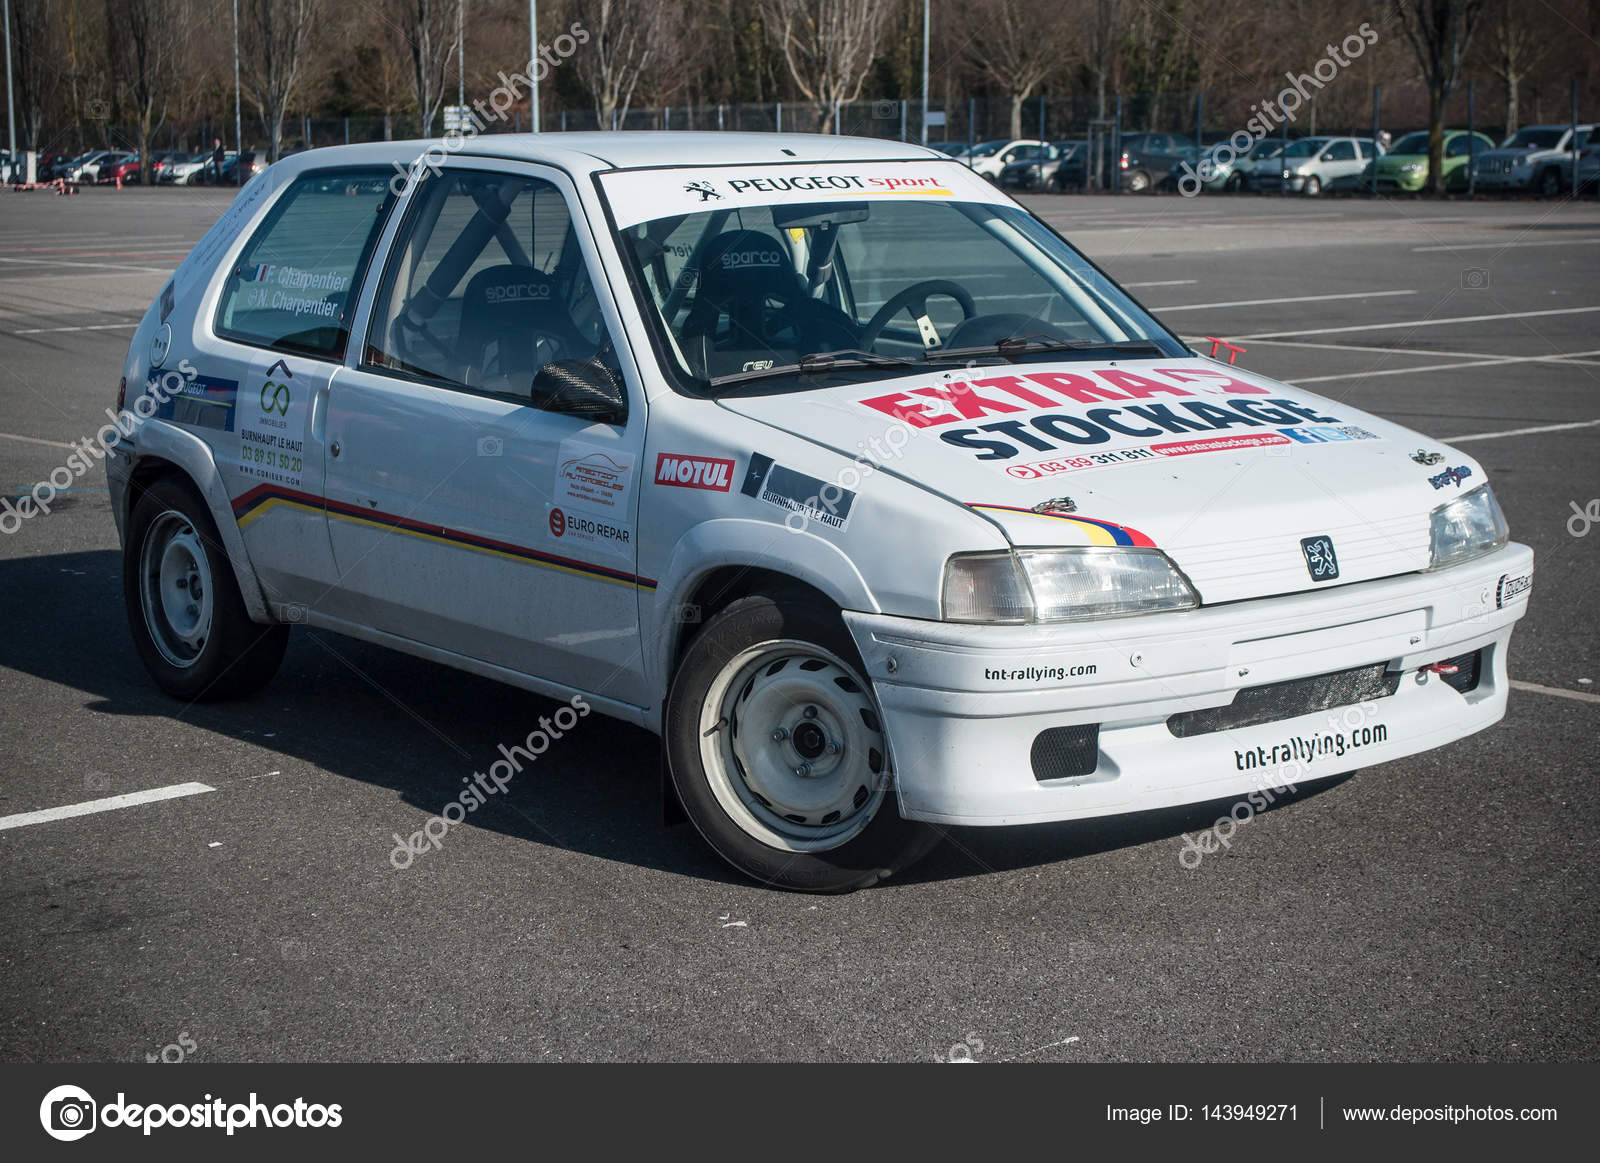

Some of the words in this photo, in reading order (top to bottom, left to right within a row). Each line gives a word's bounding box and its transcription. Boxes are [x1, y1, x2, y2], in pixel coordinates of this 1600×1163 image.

[728, 175, 865, 194] PEUGEOT
[868, 175, 946, 192] sport
[721, 250, 780, 268] sparco
[265, 264, 275, 284] F.
[278, 266, 348, 293] Charpentier
[272, 290, 338, 317] Charpentier
[485, 283, 550, 303] sparco
[858, 368, 1172, 430] EXTRA
[940, 397, 1342, 460] STOCKAGE
[242, 444, 253, 461] 03
[254, 447, 265, 464] 89
[291, 455, 303, 473] 20
[286, 438, 303, 453] HAUT
[658, 457, 729, 488] MOTUL
[1041, 461, 1066, 474] 03
[1067, 457, 1092, 470] 89
[1090, 451, 1124, 465] 311
[1125, 448, 1155, 462] 811
[762, 490, 809, 516] BURNHAUPT
[821, 512, 844, 529] HAUT
[568, 515, 595, 534] EURO
[597, 523, 630, 543] REPAR
[985, 662, 1097, 681] tnt-rallying.com
[1235, 723, 1388, 771] tnt-rallying.com
